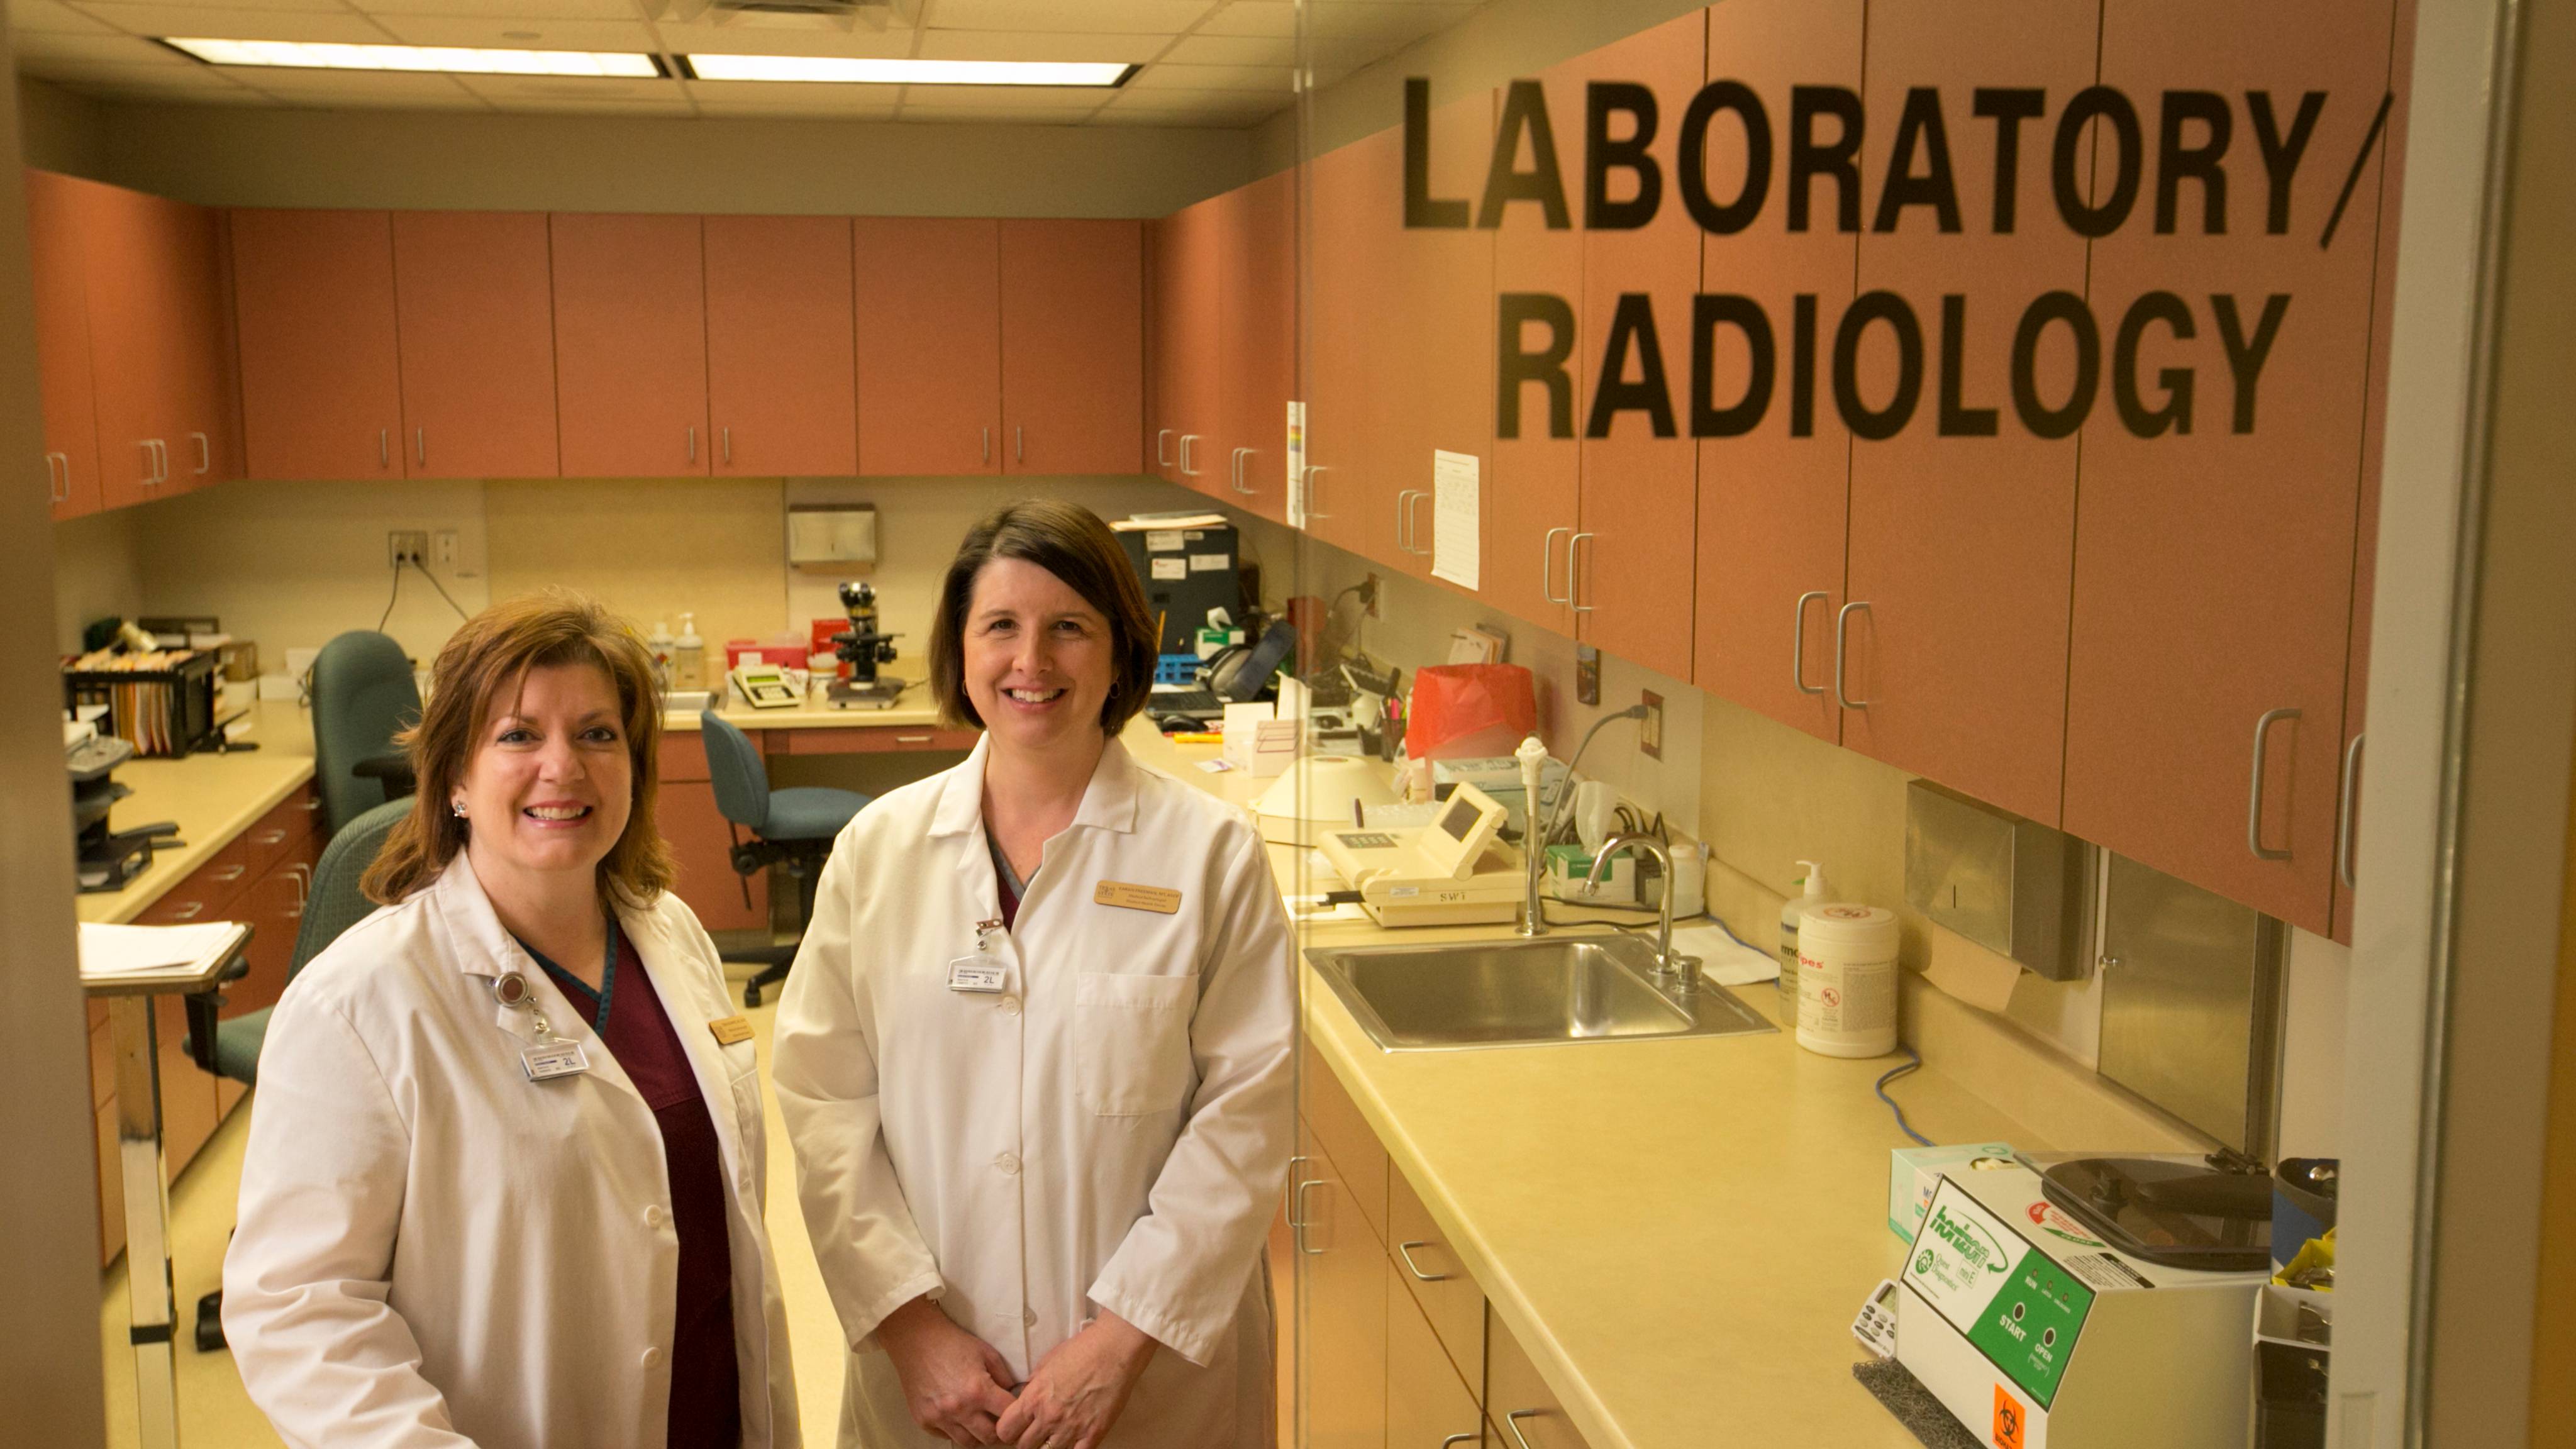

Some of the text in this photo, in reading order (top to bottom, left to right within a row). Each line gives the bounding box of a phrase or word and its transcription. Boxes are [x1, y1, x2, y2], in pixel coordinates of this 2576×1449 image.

[1403, 77, 2393, 250] LABORATORY/
[1497, 290, 2292, 440] RADIOLOGY
[984, 975, 995, 984] 2L
[563, 1057, 576, 1066] 2L
[1929, 1205, 1990, 1269] horizon
[1936, 1253, 1951, 1270] Quest
[1931, 1263, 1958, 1291] Diagnostics
[2024, 1275, 2038, 1290] RUN
[1999, 1314, 2026, 1342] START
[2035, 1343, 2053, 1363] OPEN
